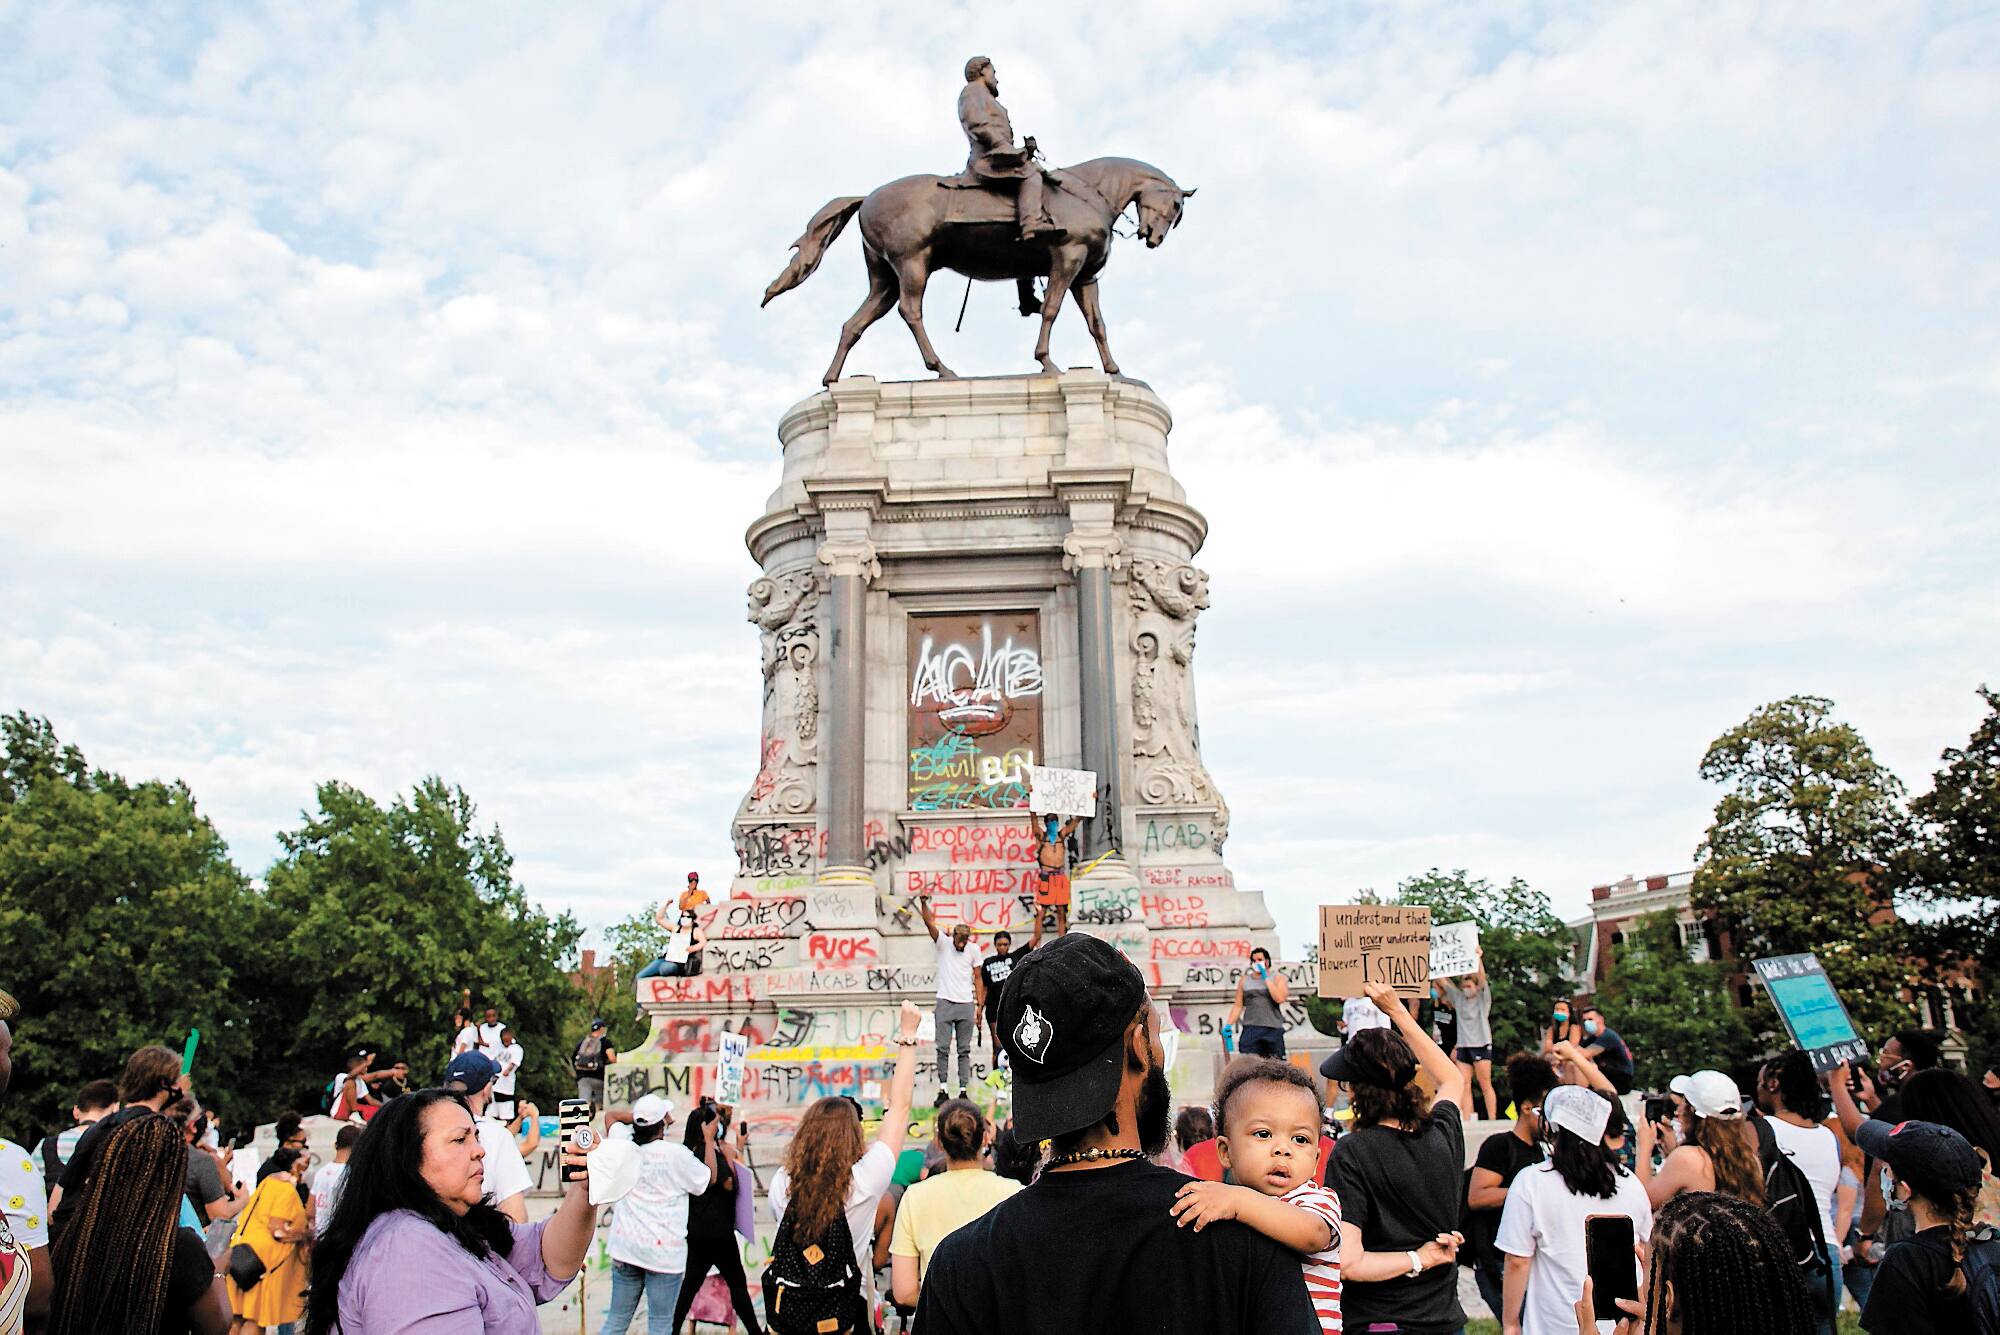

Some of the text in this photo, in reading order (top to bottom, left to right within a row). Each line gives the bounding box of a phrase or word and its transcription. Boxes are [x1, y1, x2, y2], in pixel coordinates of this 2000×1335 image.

[911, 621, 1044, 707] ACAB
[911, 826, 969, 852] BLOOD
[1144, 817, 1205, 857] ACAB
[951, 842, 1037, 864] HANDS
[728, 901, 777, 927] ONE
[931, 896, 1015, 930] FUCK
[1141, 895, 1204, 917] HOLD
[1160, 912, 1208, 930] COPS
[1323, 907, 1428, 928] I understand that
[1322, 931, 1430, 951] I will never understand
[809, 970, 858, 991] ACAB
[1186, 967, 1224, 985] END
